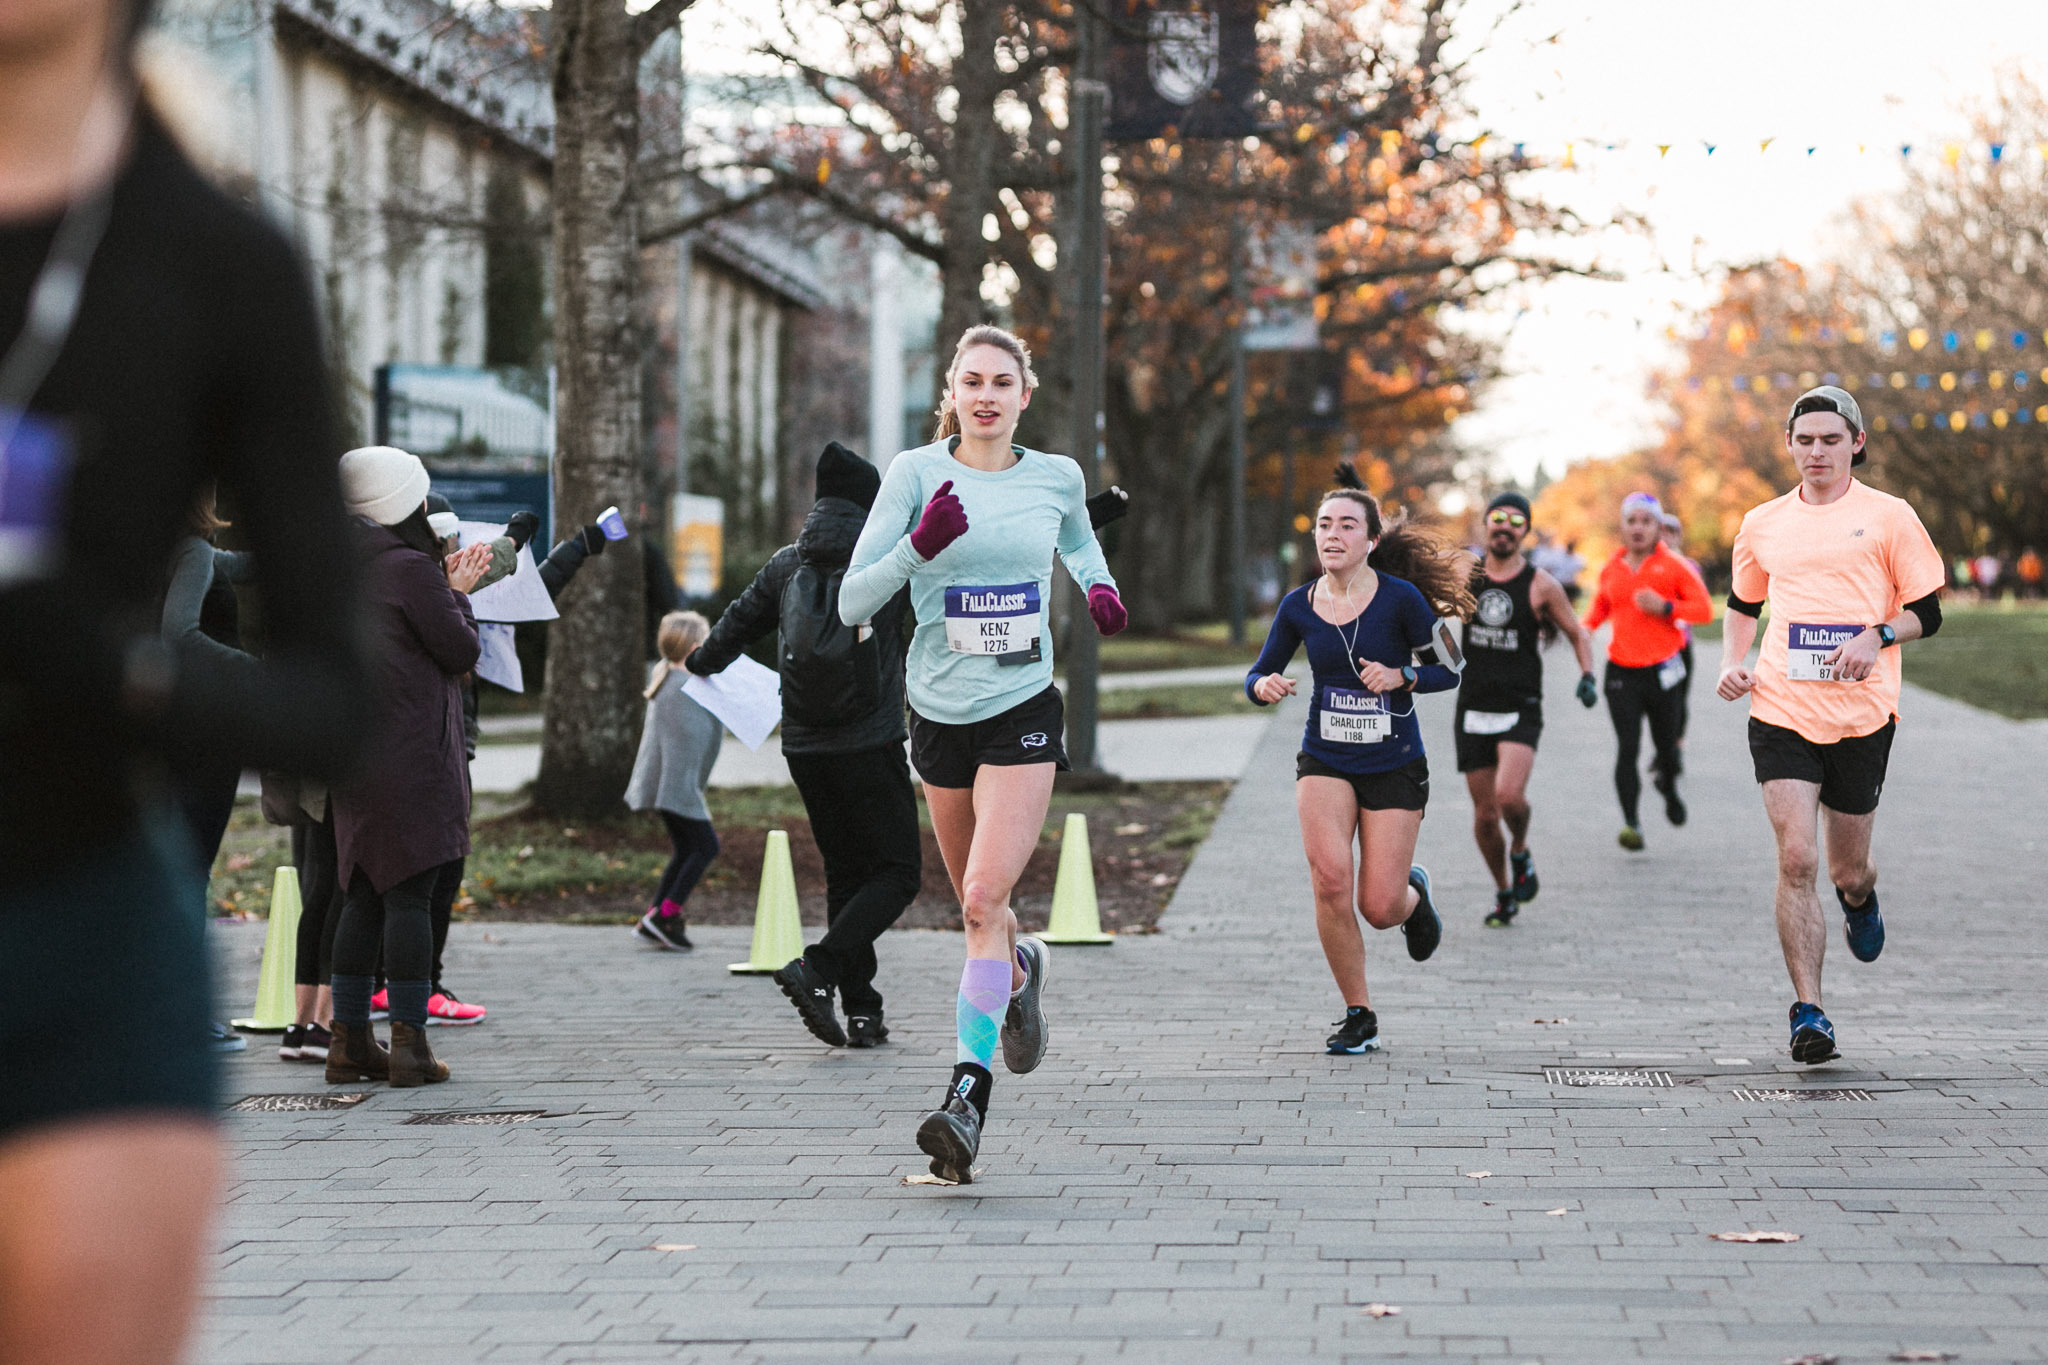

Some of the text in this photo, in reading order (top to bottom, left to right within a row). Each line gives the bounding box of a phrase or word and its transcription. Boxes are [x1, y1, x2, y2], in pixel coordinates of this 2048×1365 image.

[980, 622, 1010, 636] KENZ
[984, 640, 1008, 652] 1275
[1819, 668, 1831, 679] 87
[1330, 716, 1378, 729] CHARLOTTE
[1344, 732, 1363, 742] 1188
